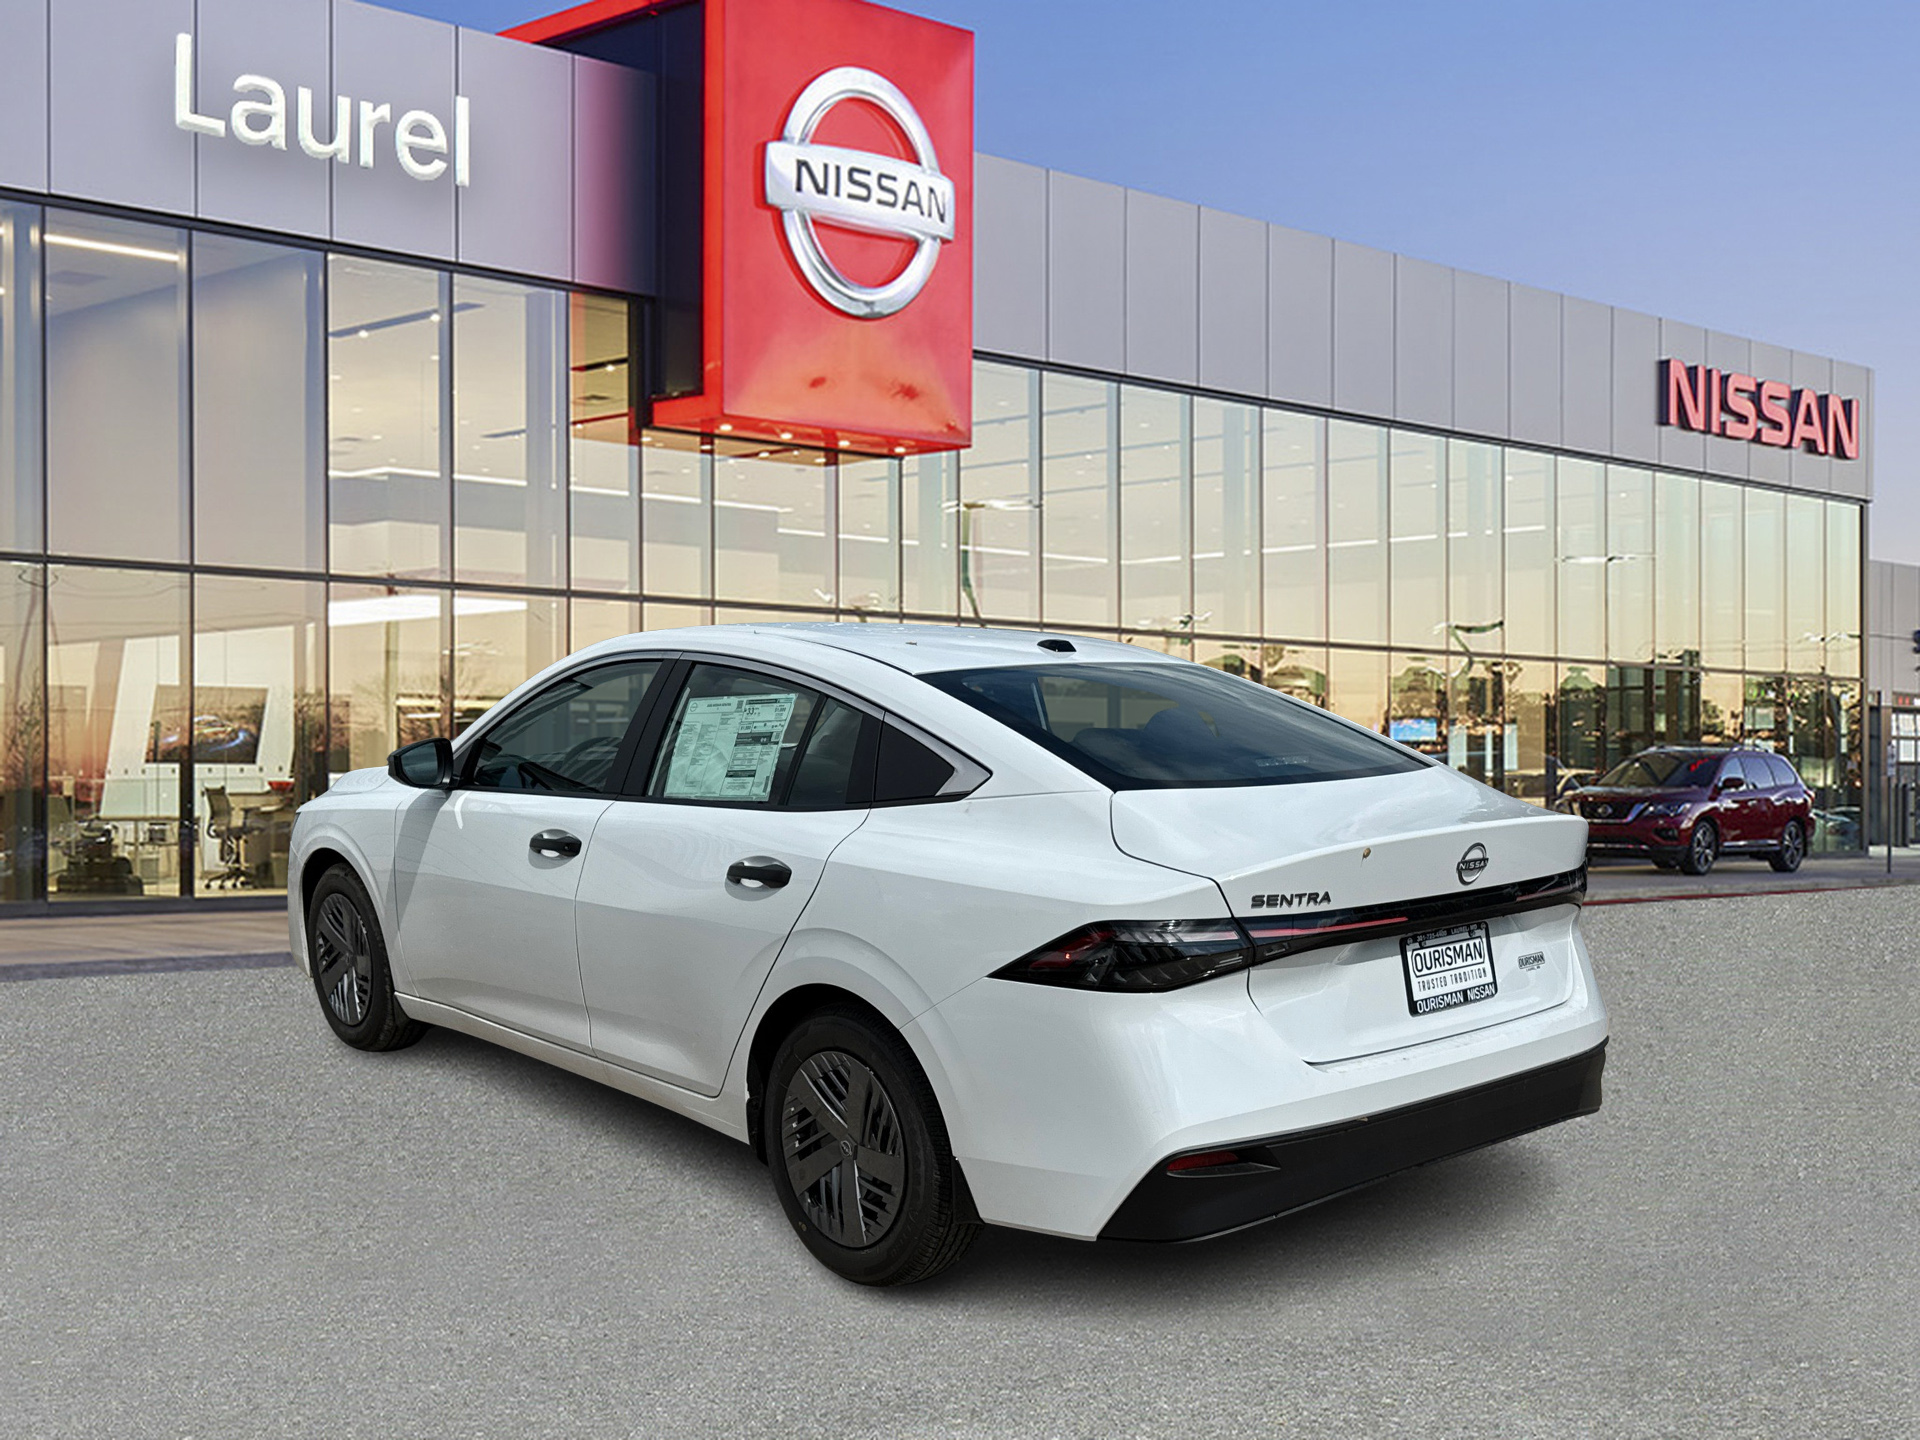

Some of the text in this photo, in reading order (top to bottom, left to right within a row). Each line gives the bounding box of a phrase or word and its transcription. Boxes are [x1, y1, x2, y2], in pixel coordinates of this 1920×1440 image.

[175, 33, 470, 187] Laurel
[795, 159, 946, 224] NISSAN
[1660, 358, 1859, 459] NISSAN
[1251, 891, 1331, 909] SENTRA
[1414, 941, 1483, 973] OURISMAN
[1518, 954, 1545, 968] OURISMAN
[1417, 967, 1488, 992] TRUSTED TRADITION
[1416, 984, 1496, 1013] OURISMAN NISSAN
